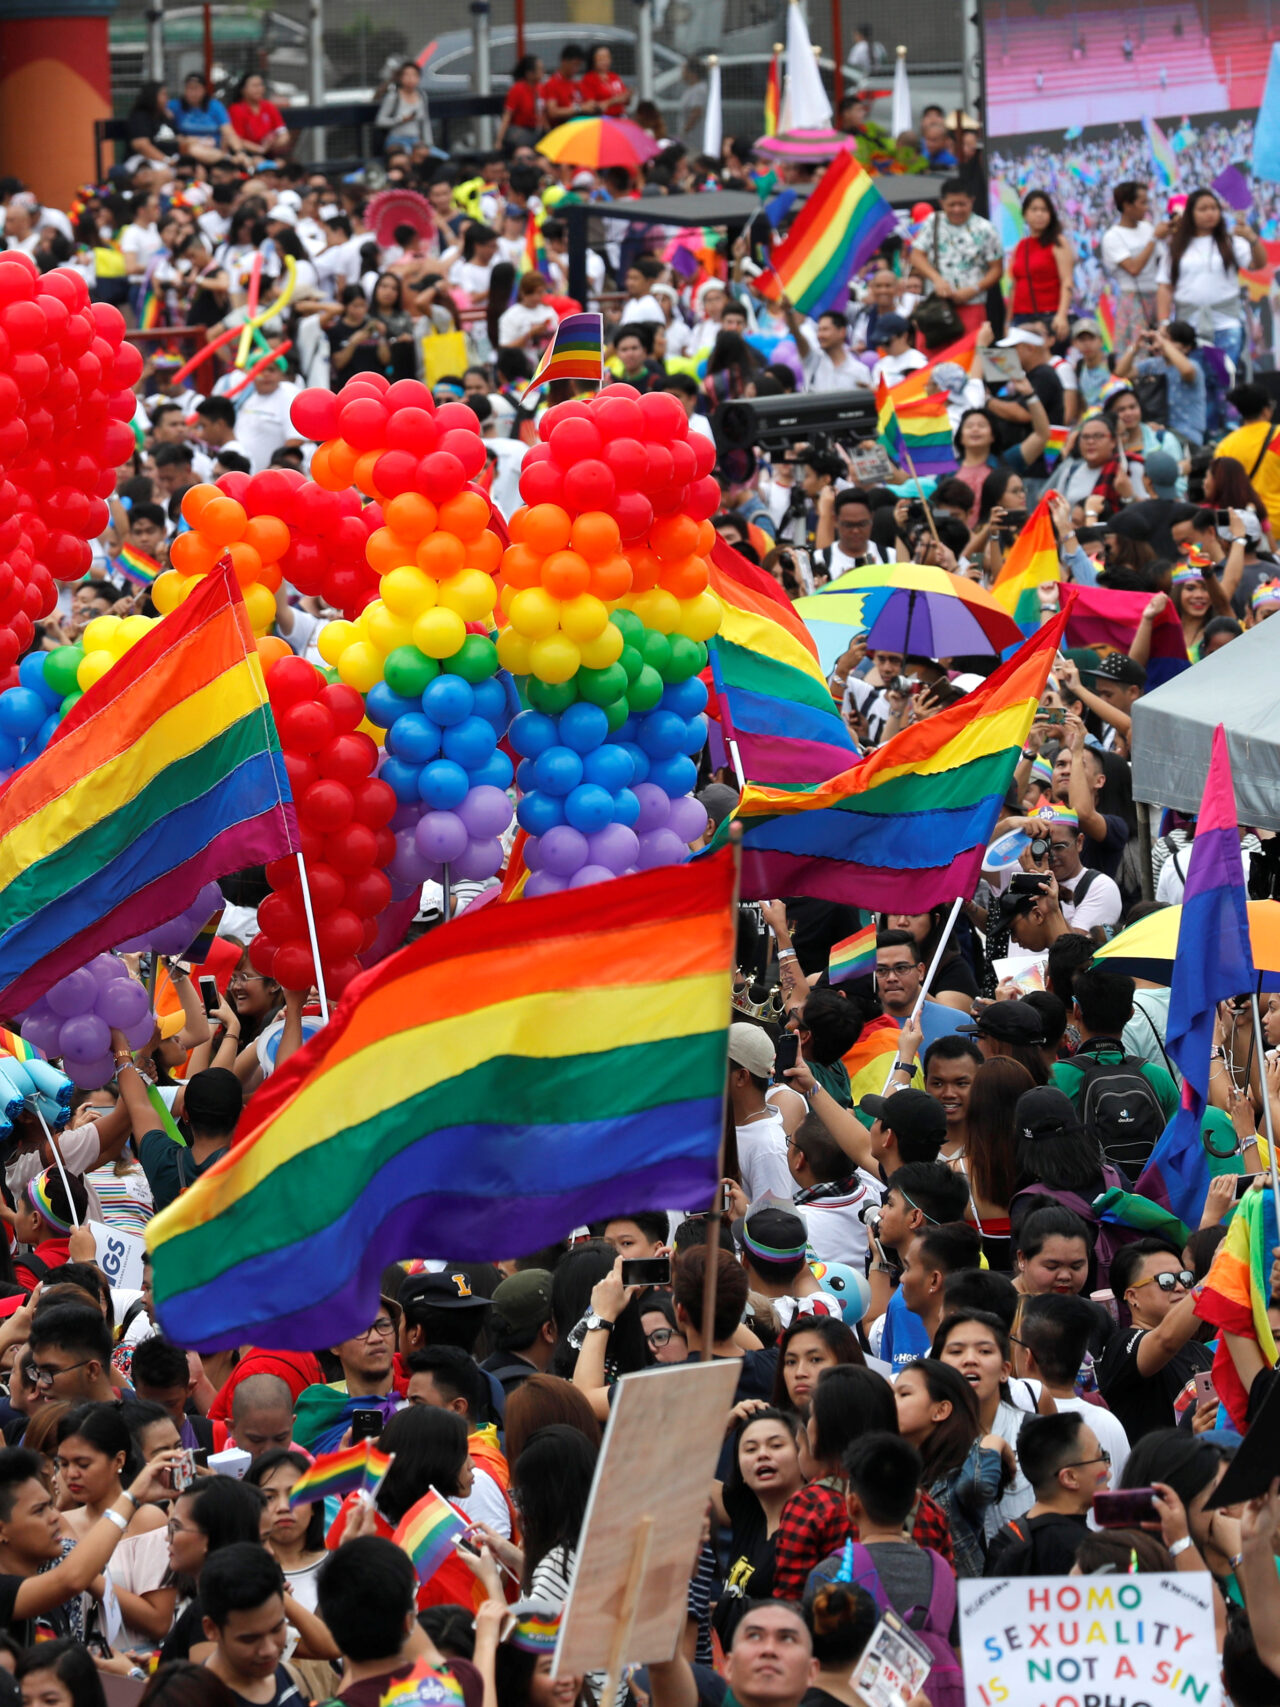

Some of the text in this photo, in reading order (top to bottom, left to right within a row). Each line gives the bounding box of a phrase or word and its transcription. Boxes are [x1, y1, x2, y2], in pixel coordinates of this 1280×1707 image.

[1029, 1584, 1142, 1612] HOMO
[984, 1619, 1194, 1662] SEXUALITY
[977, 1677, 1010, 1707] IS
[1027, 1657, 1099, 1683] NOT
[1114, 1655, 1137, 1680] A
[1152, 1660, 1210, 1704] SIN
